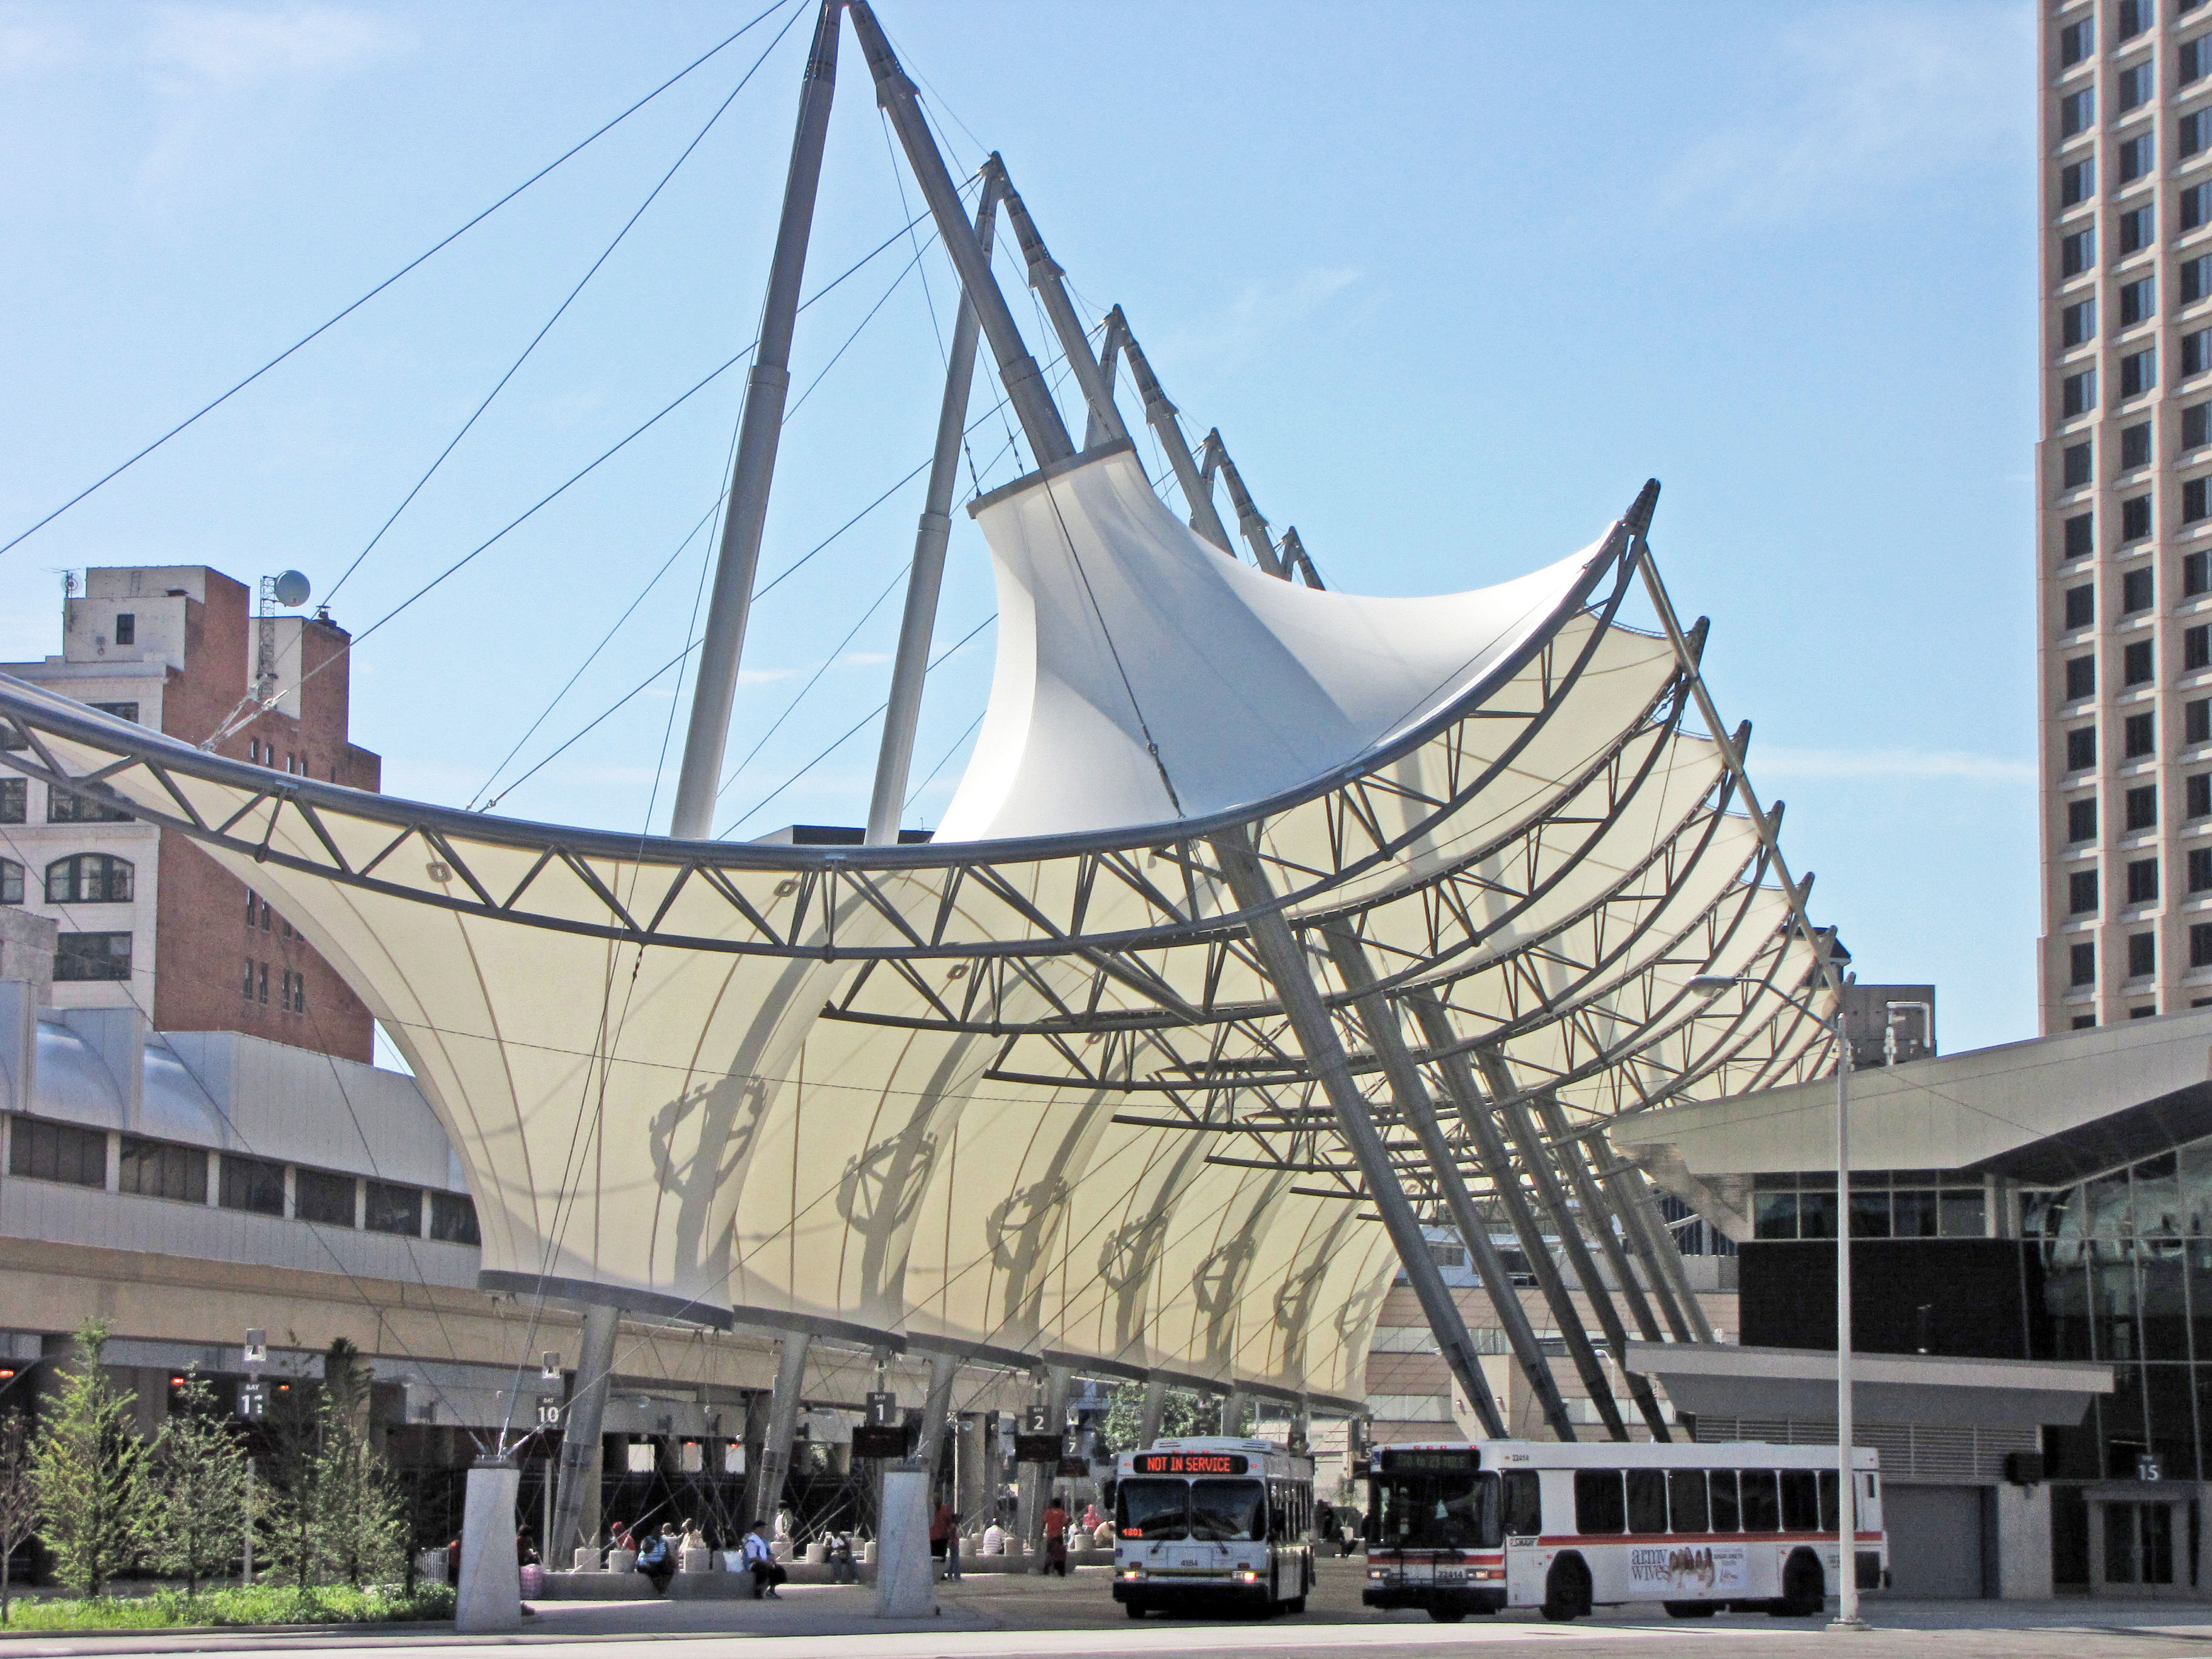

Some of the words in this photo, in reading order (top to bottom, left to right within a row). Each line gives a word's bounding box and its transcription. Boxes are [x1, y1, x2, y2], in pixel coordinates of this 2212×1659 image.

[538, 1407, 559, 1423] 10
[876, 1404, 883, 1420] 1
[1033, 1415, 1044, 1430] 2
[1069, 1442, 1076, 1453] 7
[1365, 1447, 1372, 1458] 5
[1147, 1457, 1167, 1471] NOT
[1171, 1457, 1183, 1471] IN
[1186, 1458, 1230, 1472] SERVICE
[2138, 1464, 2158, 1480] 15
[1632, 1549, 1667, 1564] army
